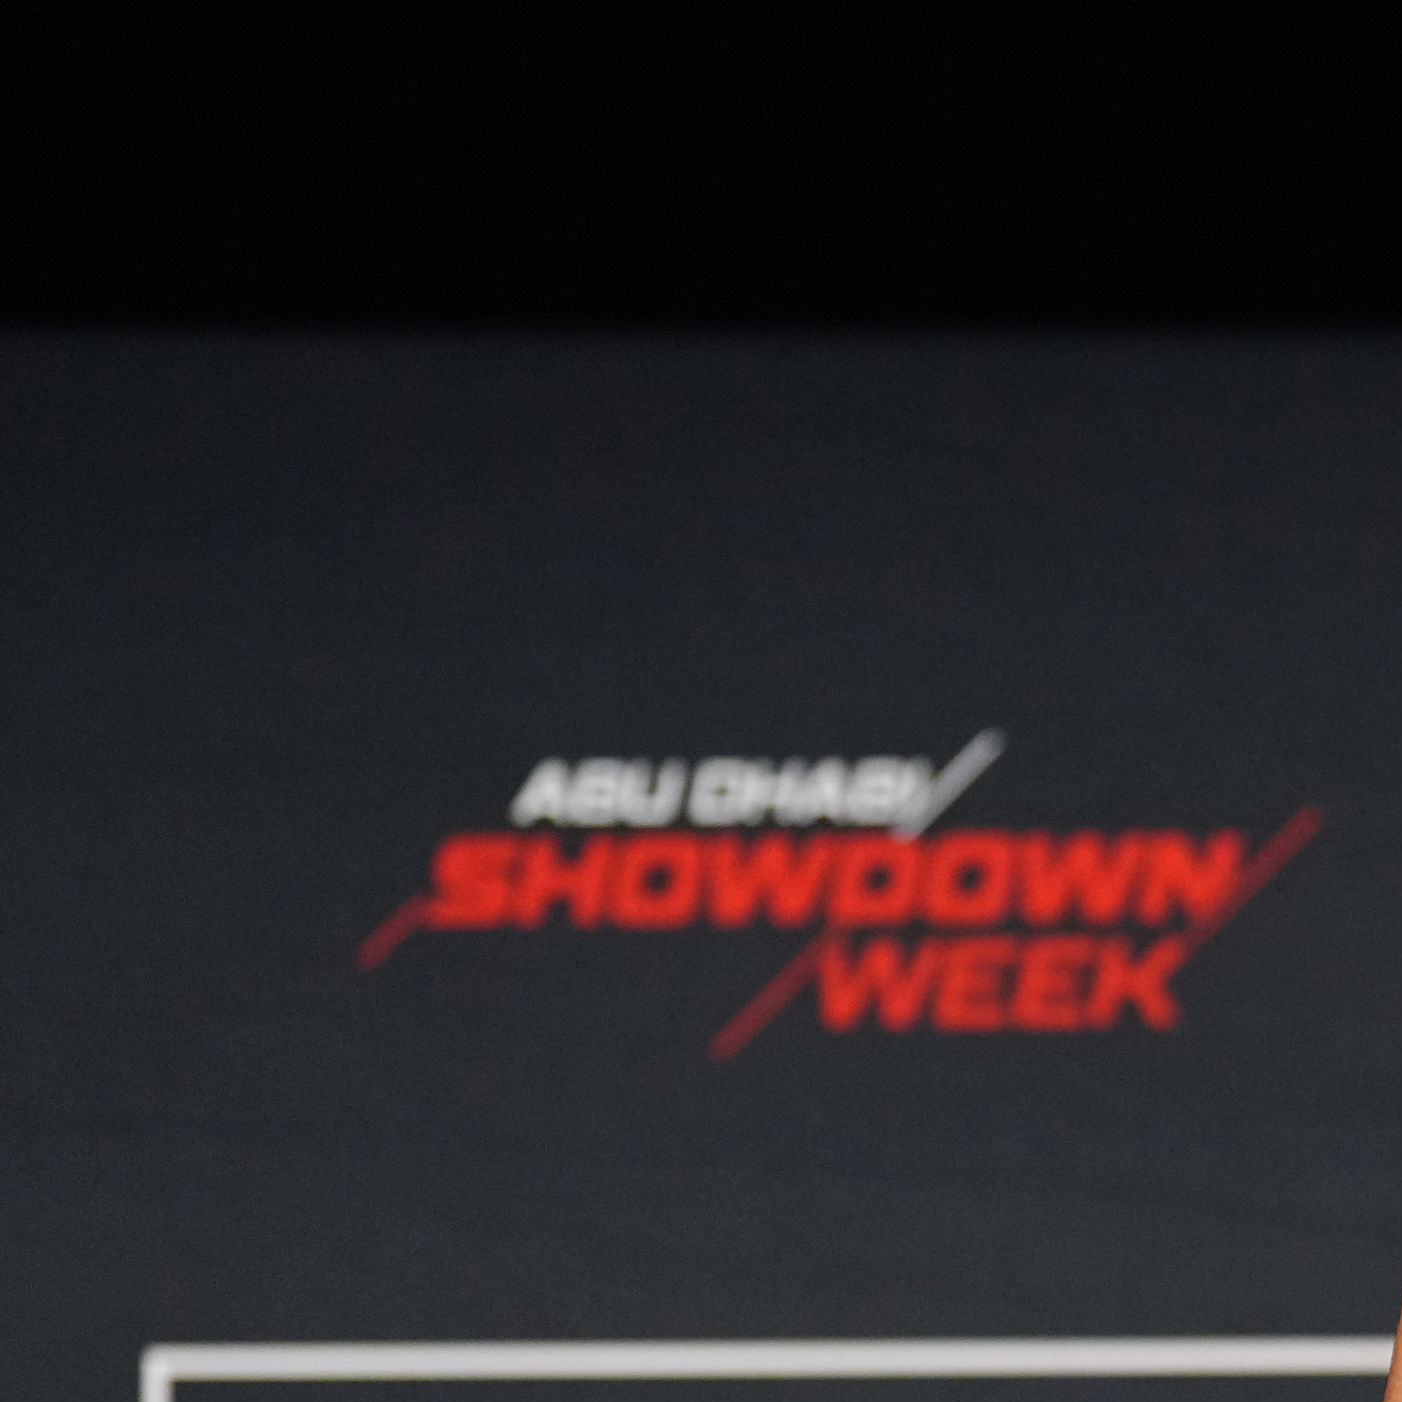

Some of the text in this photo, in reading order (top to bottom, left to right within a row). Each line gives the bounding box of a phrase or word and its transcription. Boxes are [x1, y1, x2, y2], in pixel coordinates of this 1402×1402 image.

[511, 757, 935, 828] ABU DHABI
[429, 831, 1245, 928] SHOWDOWN
[818, 935, 1182, 1031] WEEK
